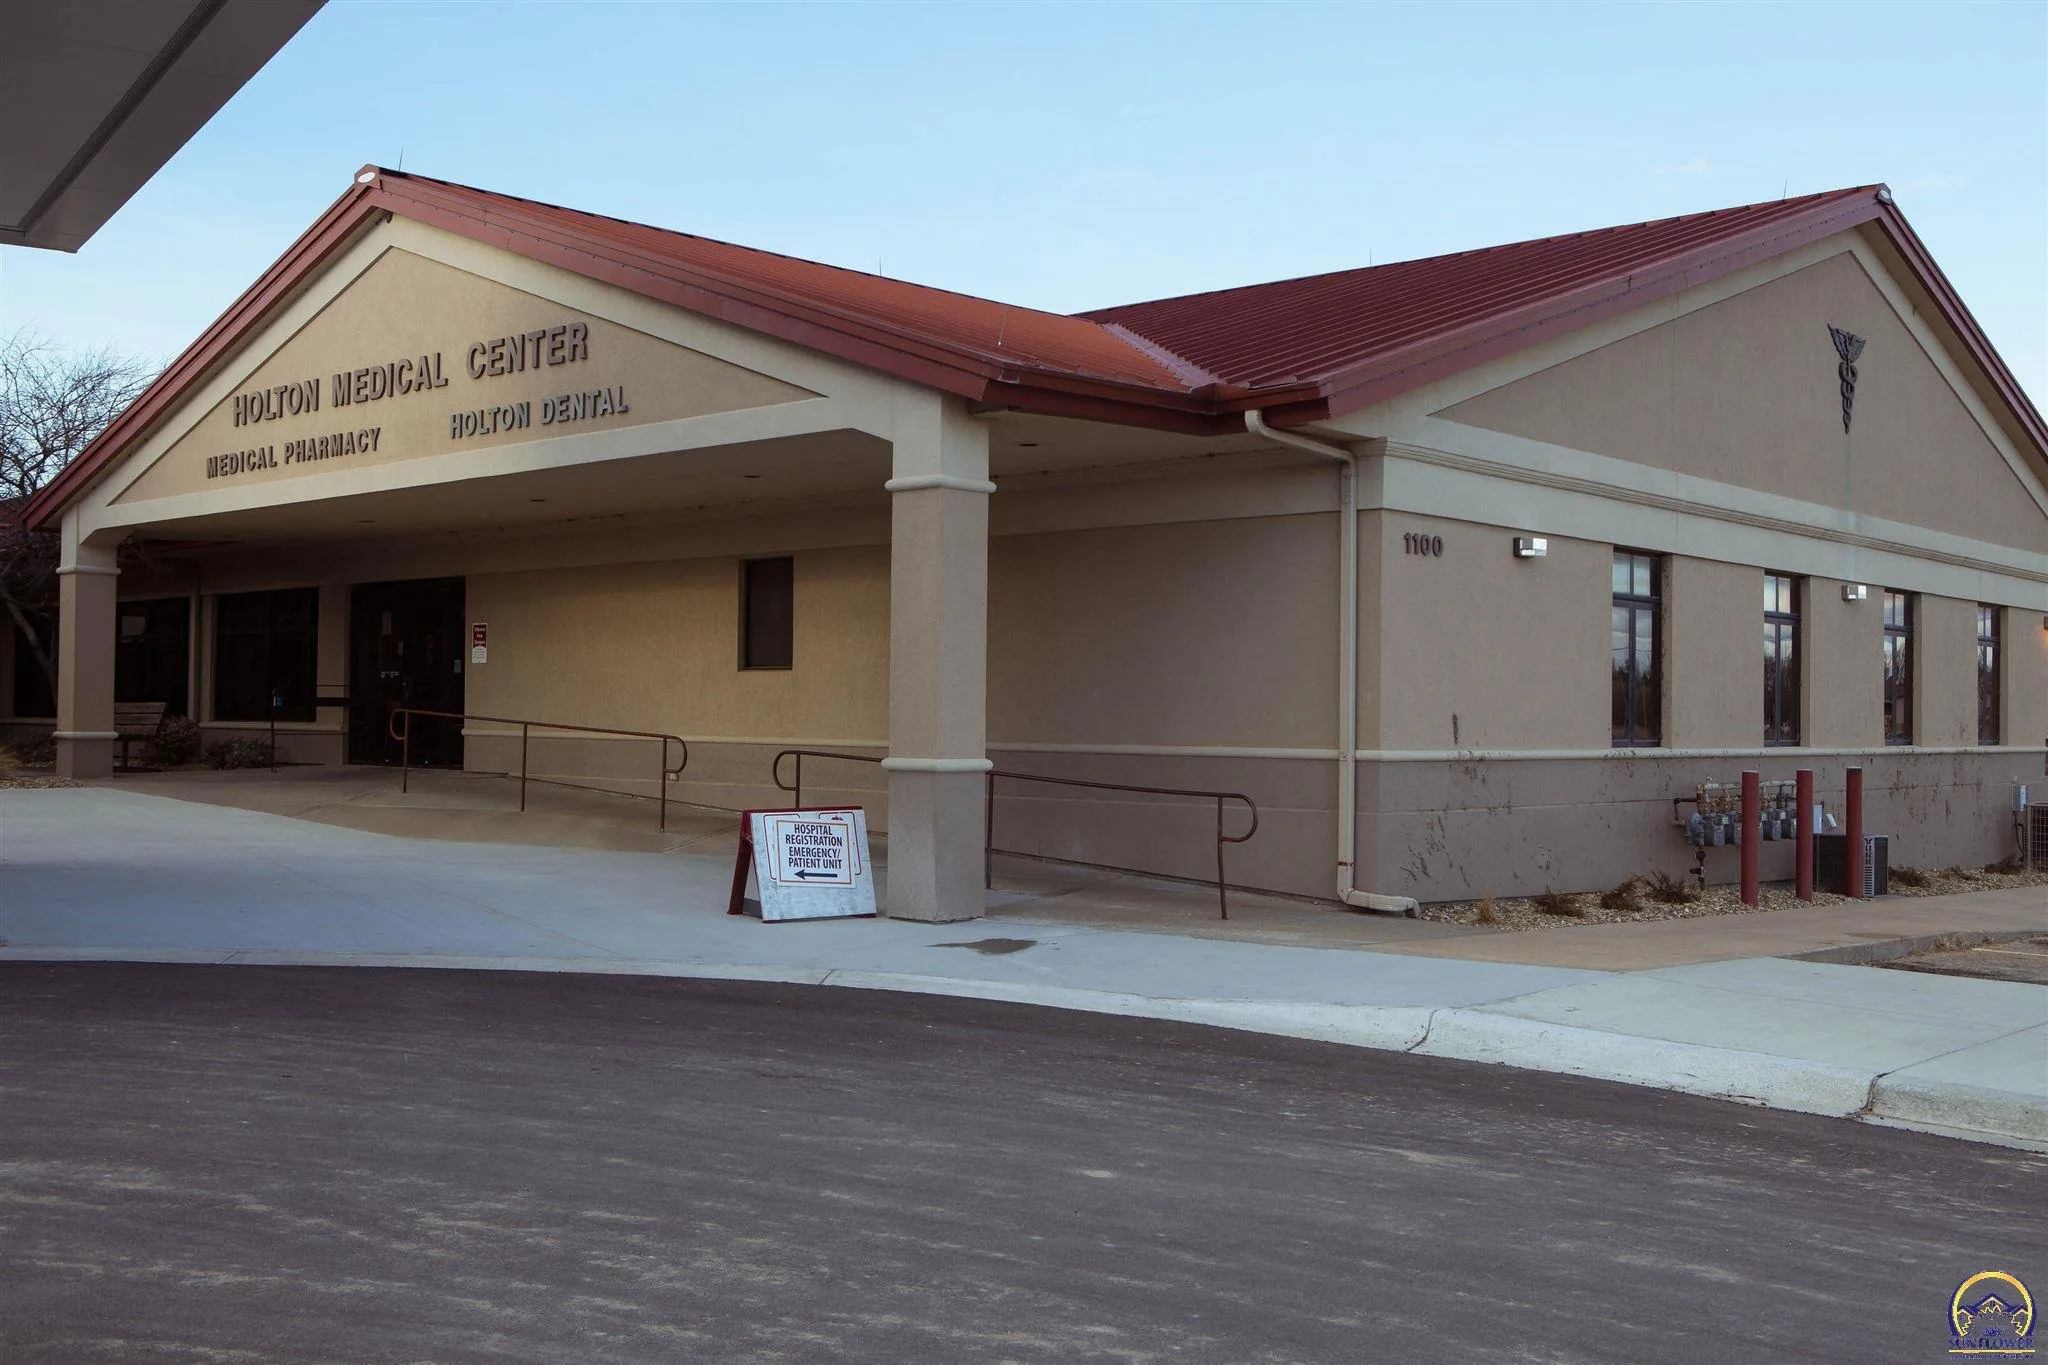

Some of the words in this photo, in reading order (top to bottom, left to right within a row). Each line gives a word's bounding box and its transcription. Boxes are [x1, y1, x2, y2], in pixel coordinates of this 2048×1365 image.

[232, 378, 320, 427] HOLTON
[332, 352, 448, 408] MEDICAL
[465, 321, 588, 379] CENTER
[449, 400, 531, 439] HOLTON
[540, 385, 629, 425] DENTAL
[206, 445, 278, 479] MEDICAL
[284, 427, 381, 465] PHARMACY
[1403, 532, 1443, 558] 1100
[794, 824, 833, 835] HOSPITAL
[785, 834, 842, 846] REGISTRATION
[789, 847, 840, 858] EMERGENCY/
[788, 858, 820, 868] PATIENT
[823, 859, 842, 869] UNIT
